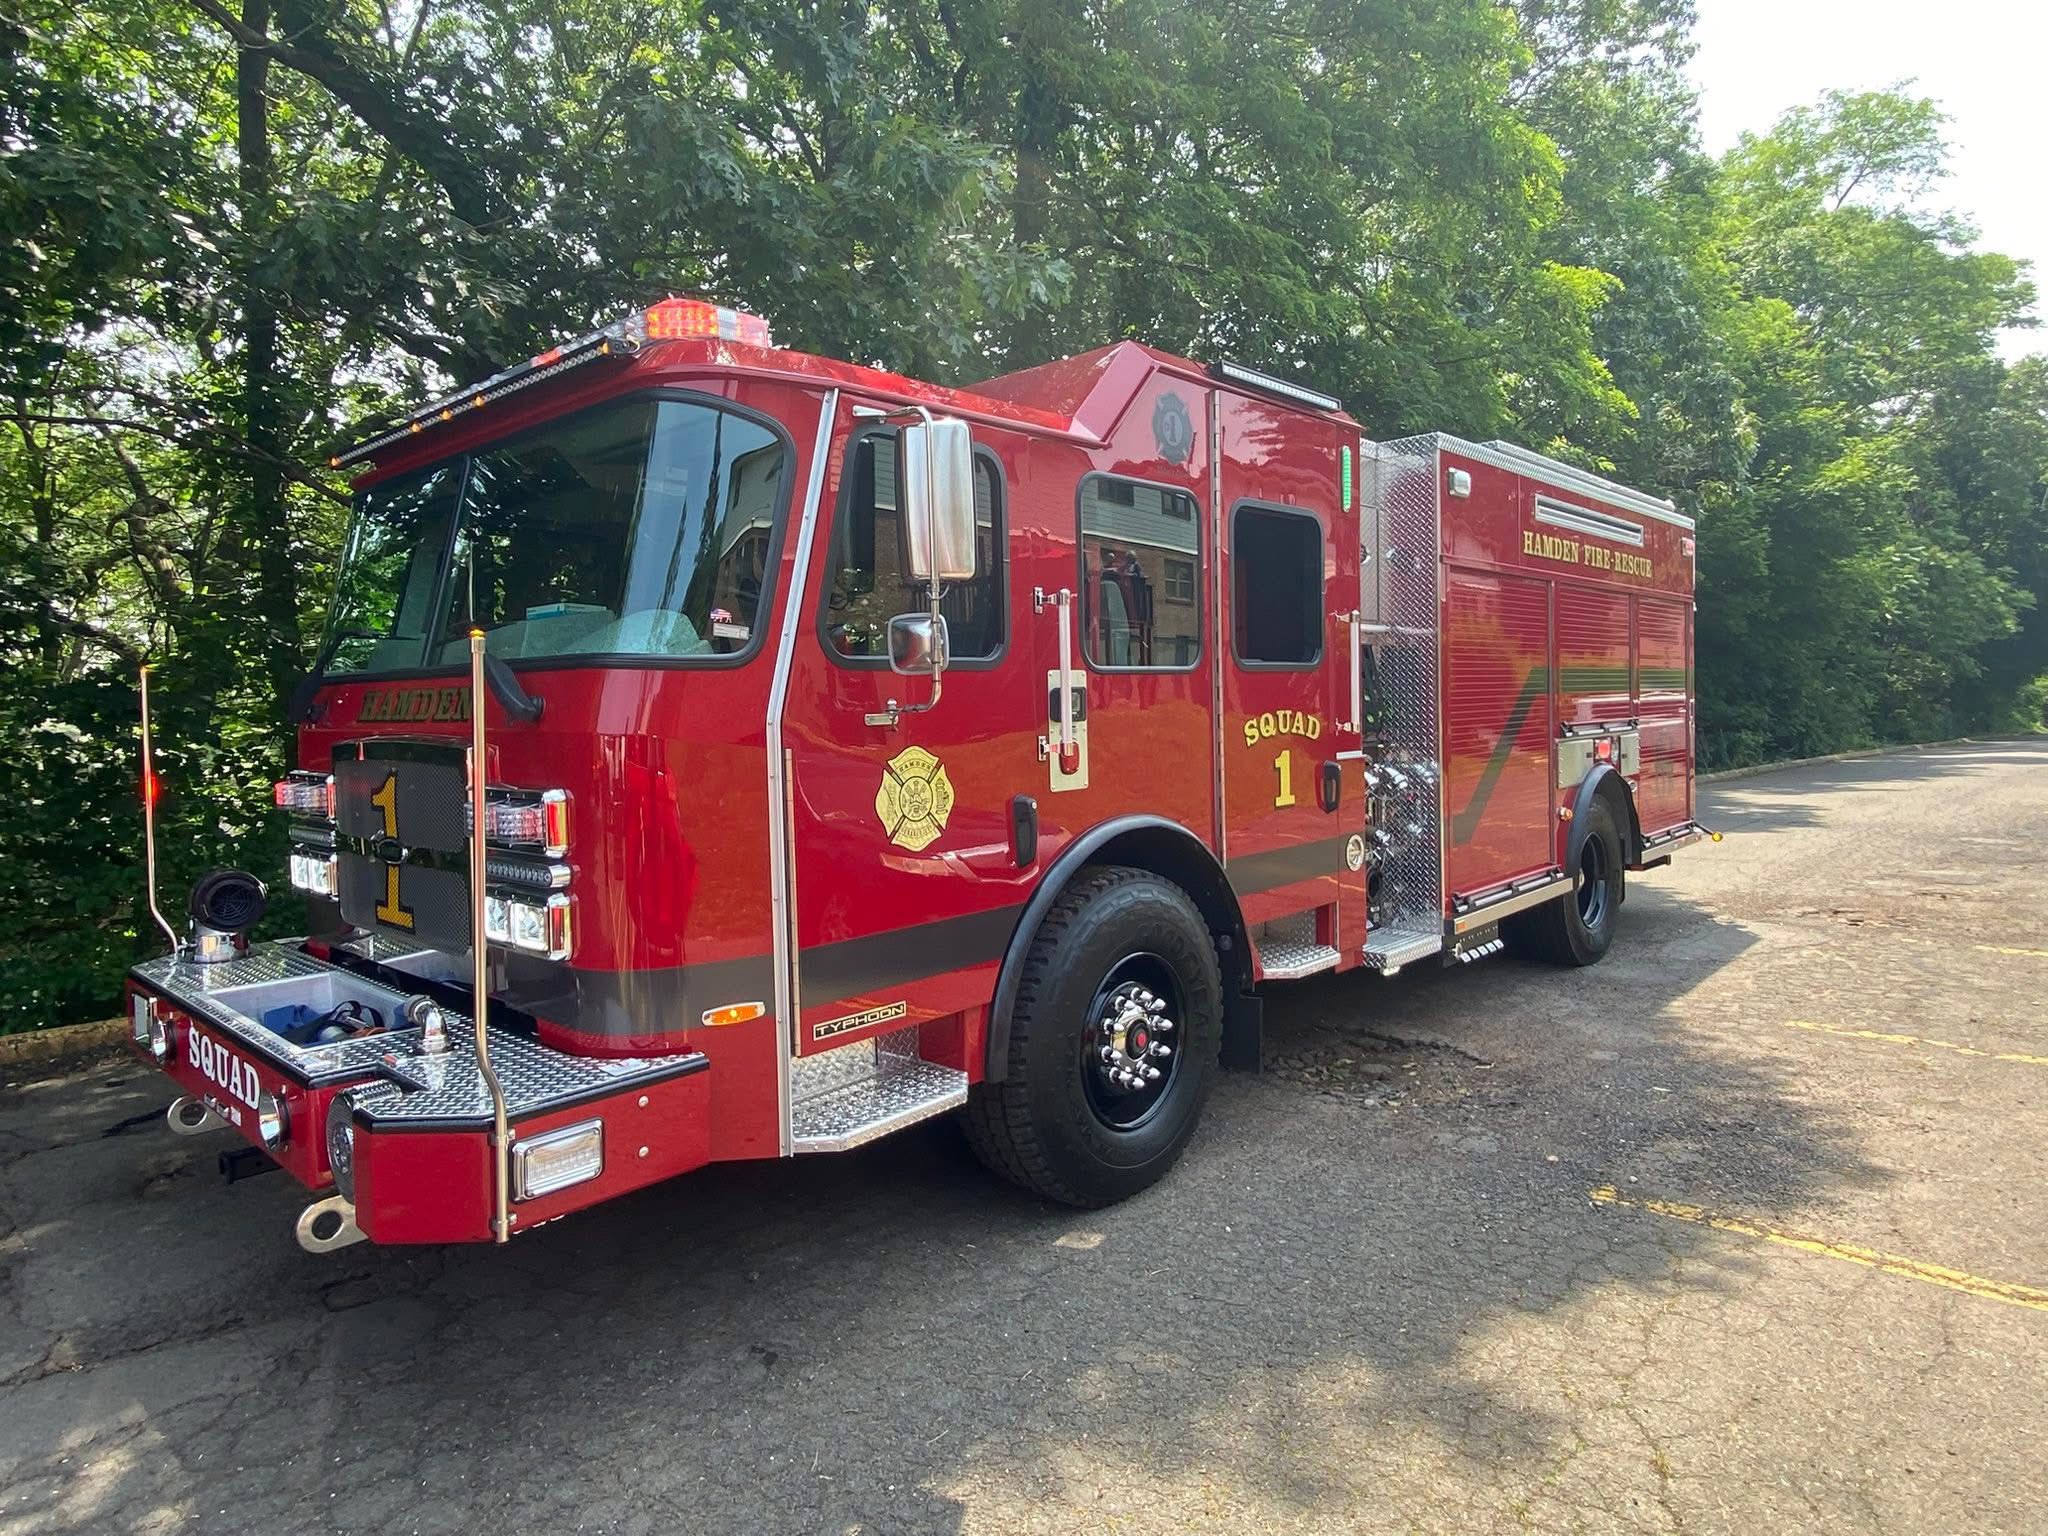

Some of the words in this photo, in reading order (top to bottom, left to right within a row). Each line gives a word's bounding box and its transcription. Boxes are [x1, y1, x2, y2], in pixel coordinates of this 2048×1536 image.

[1523, 530, 1580, 564] HAMDEN
[1583, 543, 1653, 578] FIRE-RESCUE
[1243, 710, 1321, 747] SQUAD
[1274, 749, 1296, 809] 1
[371, 770, 416, 933] 1
[816, 1005, 904, 1036] TYPHOON
[188, 1024, 261, 1111] SQUAD
